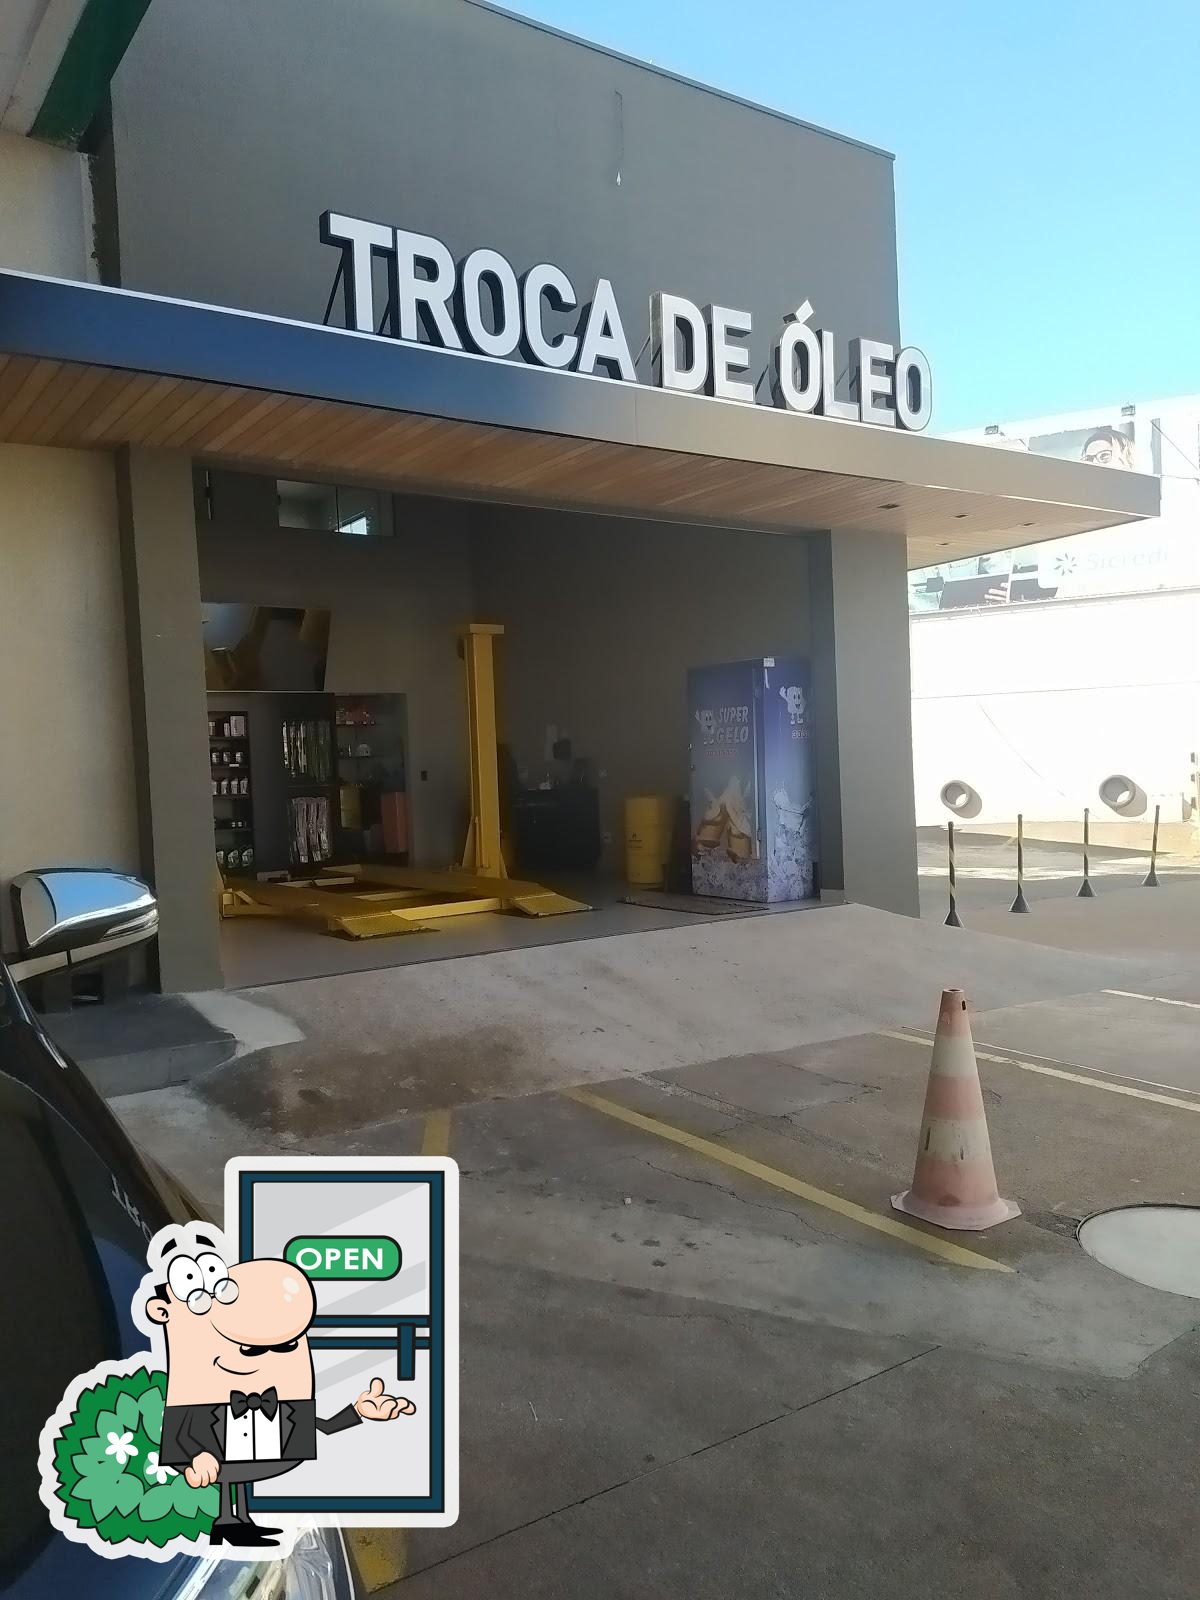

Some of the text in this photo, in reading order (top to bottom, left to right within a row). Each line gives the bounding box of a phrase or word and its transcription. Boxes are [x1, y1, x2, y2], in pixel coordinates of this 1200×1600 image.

[321, 210, 932, 431] TROCA DE ÓLEO
[719, 705, 749, 723] SUPER
[716, 726, 749, 744] GELO
